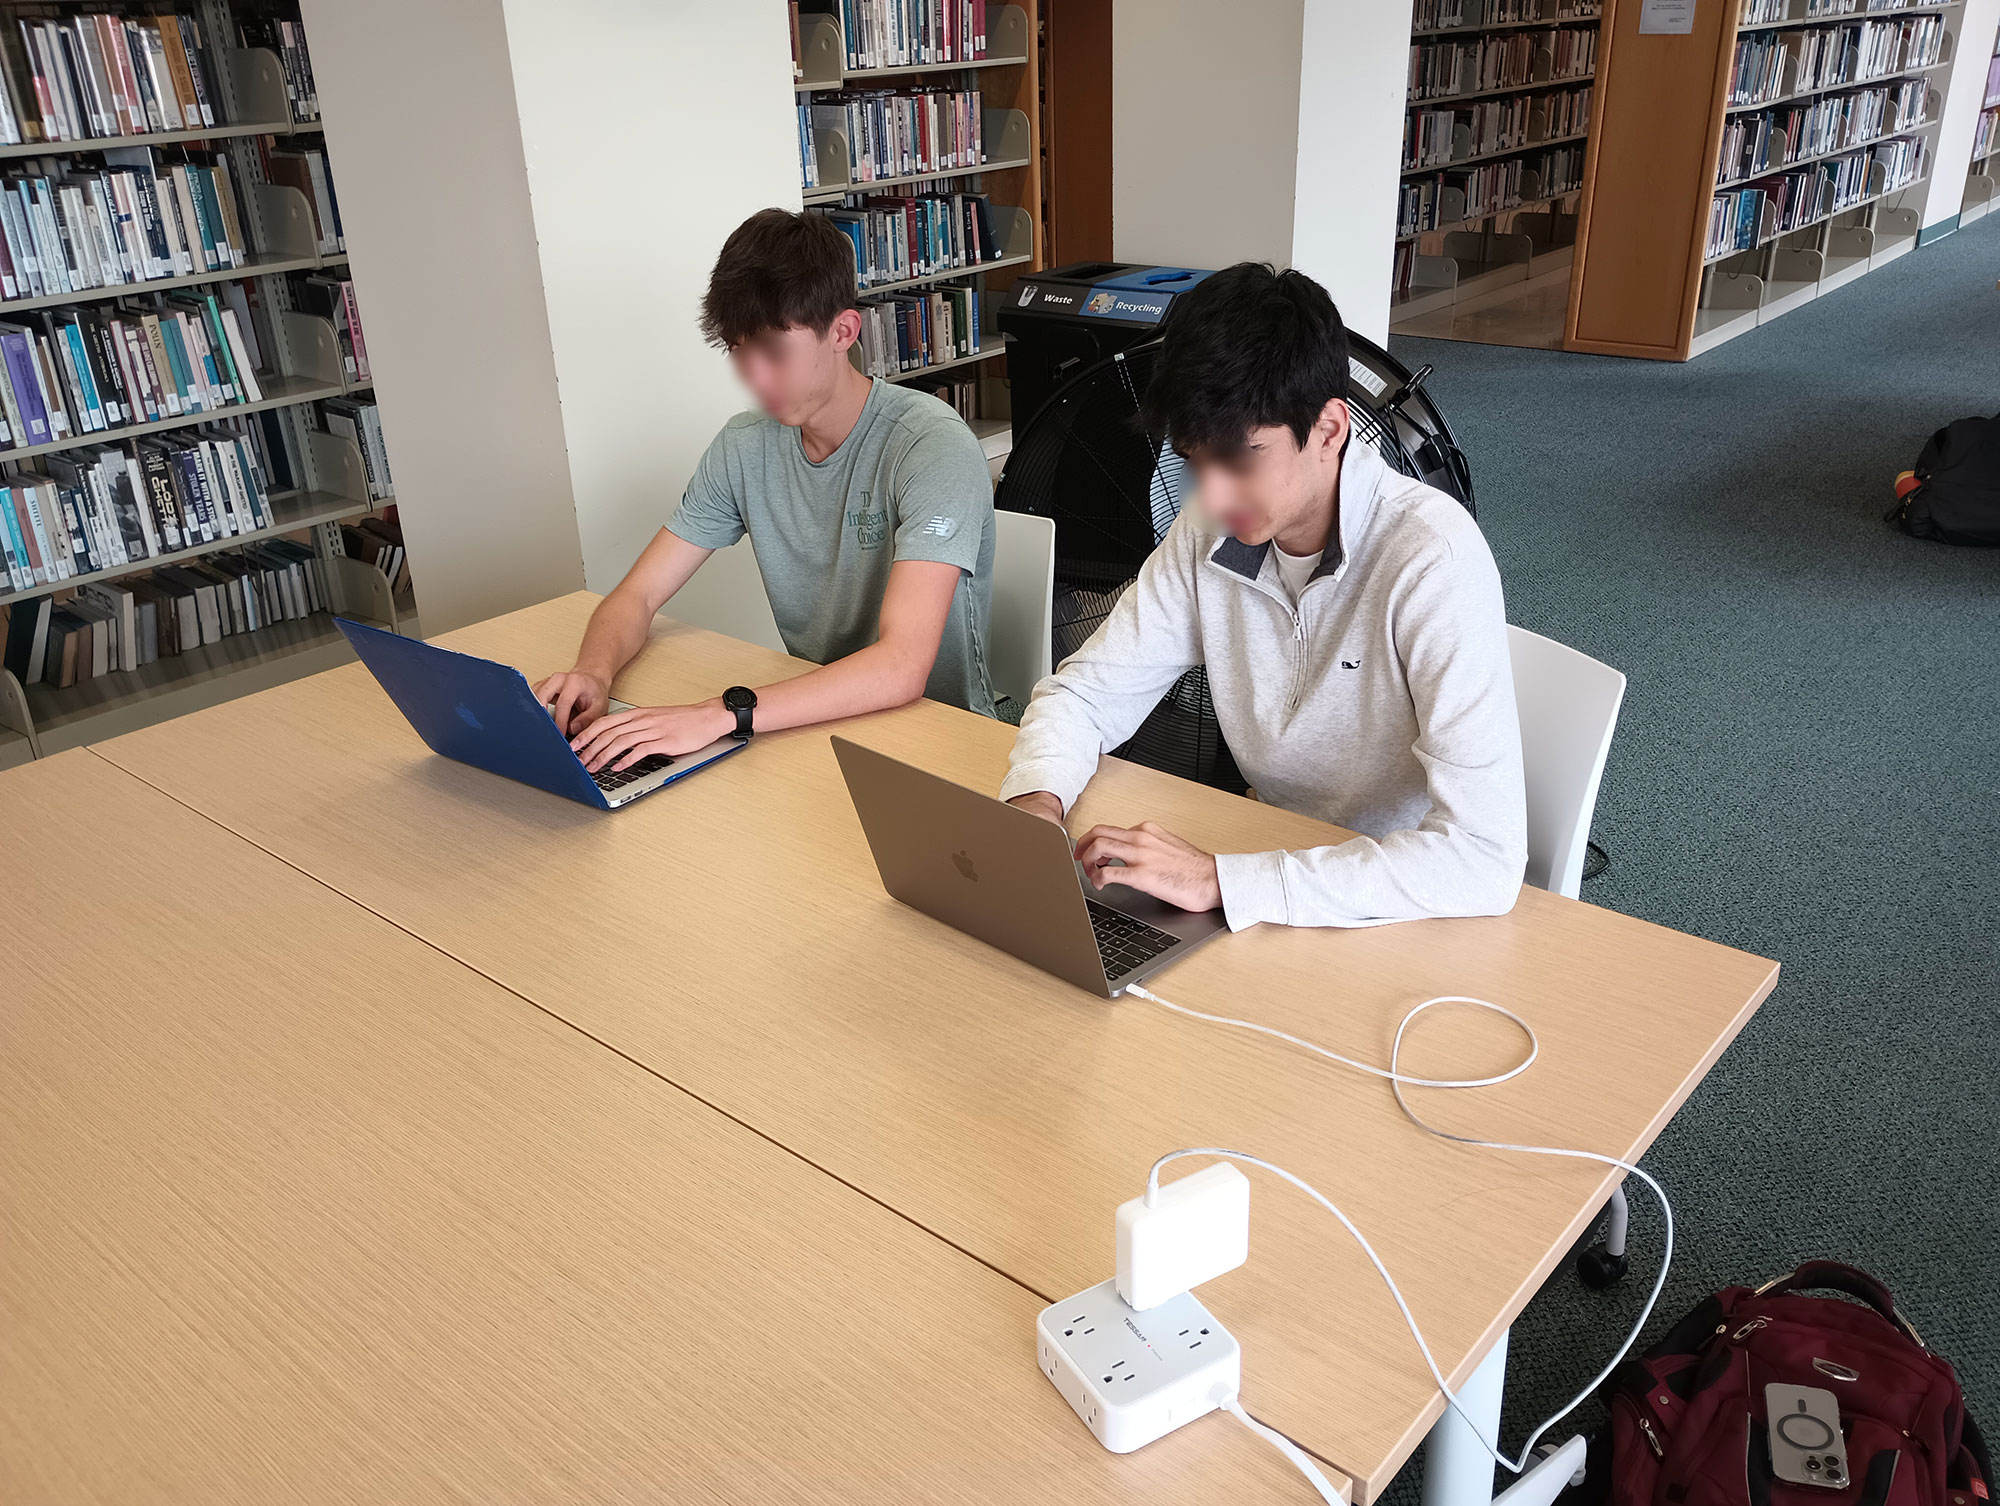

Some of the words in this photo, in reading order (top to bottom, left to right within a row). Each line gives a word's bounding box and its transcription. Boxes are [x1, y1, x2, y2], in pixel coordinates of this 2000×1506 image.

[102, 176, 112, 197] Signs
[108, 198, 115, 207] of
[110, 208, 119, 224] Life
[1044, 294, 1073, 304] Waste
[1116, 301, 1162, 315] Recycling
[193, 452, 204, 473] MARK
[200, 481, 211, 501] WITH
[207, 507, 216, 521] STO
[152, 477, 169, 529] GHETTO
[189, 473, 201, 497] STOLEN
[196, 500, 206, 521] YEARS
[239, 491, 248, 510] GHETTO
